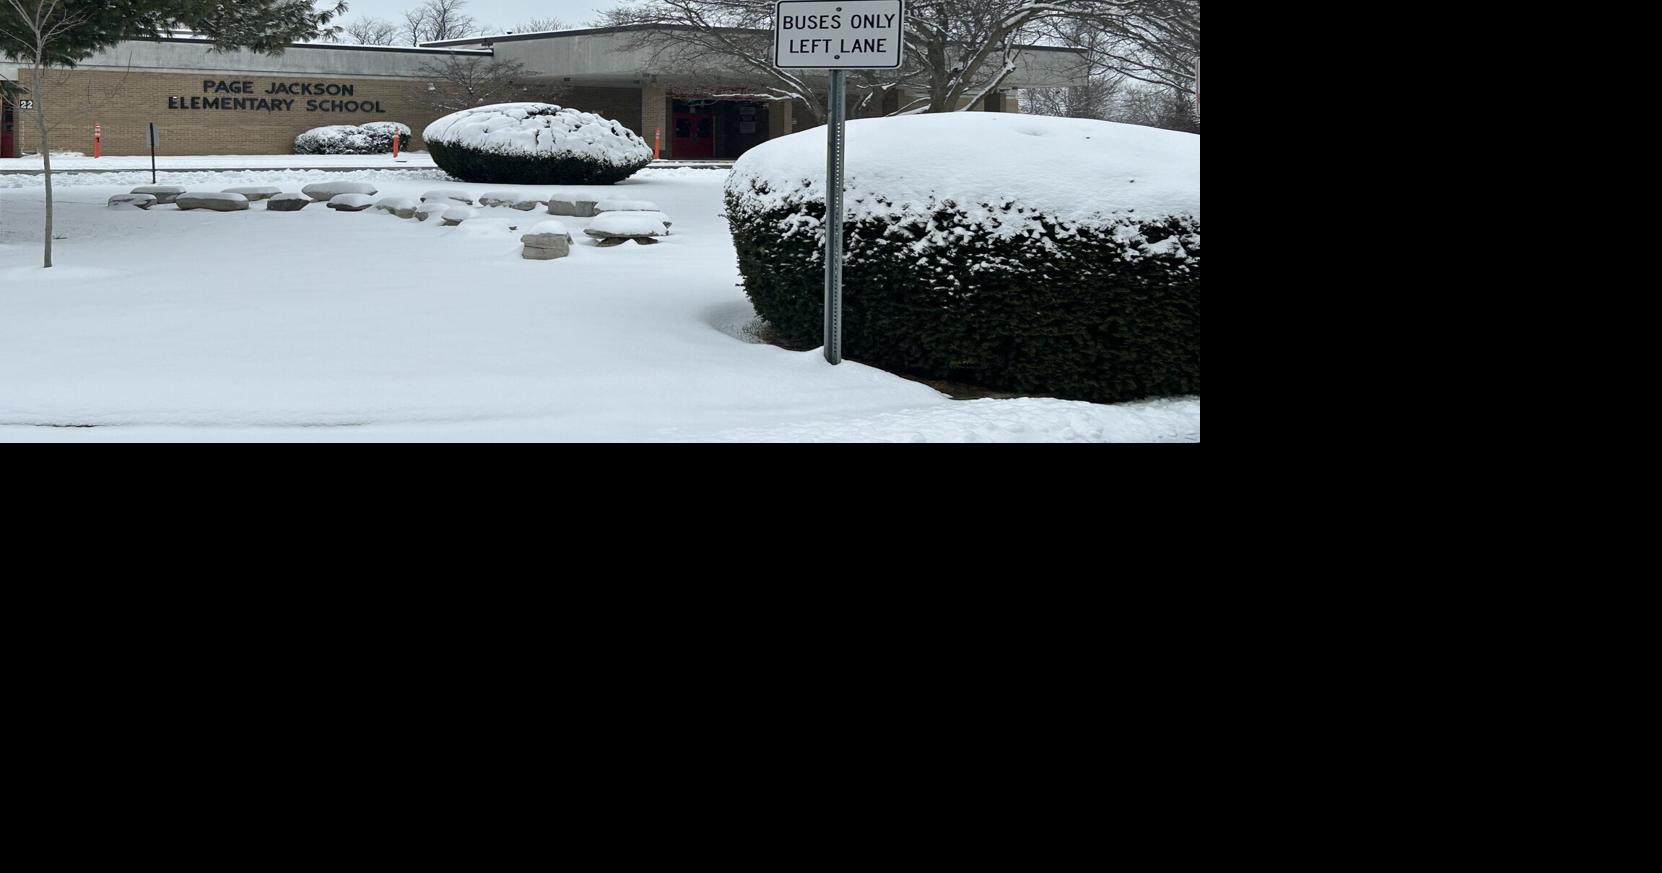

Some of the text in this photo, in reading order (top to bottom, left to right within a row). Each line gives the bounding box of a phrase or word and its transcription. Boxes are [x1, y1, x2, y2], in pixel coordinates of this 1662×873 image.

[783, 13, 896, 30] BUSES ONLY
[789, 38, 887, 54] LEFT LANE
[203, 80, 354, 96] PAGE JACKSON
[20, 100, 33, 109] 22
[168, 96, 386, 113] ELEMENTARY SCHOOL
